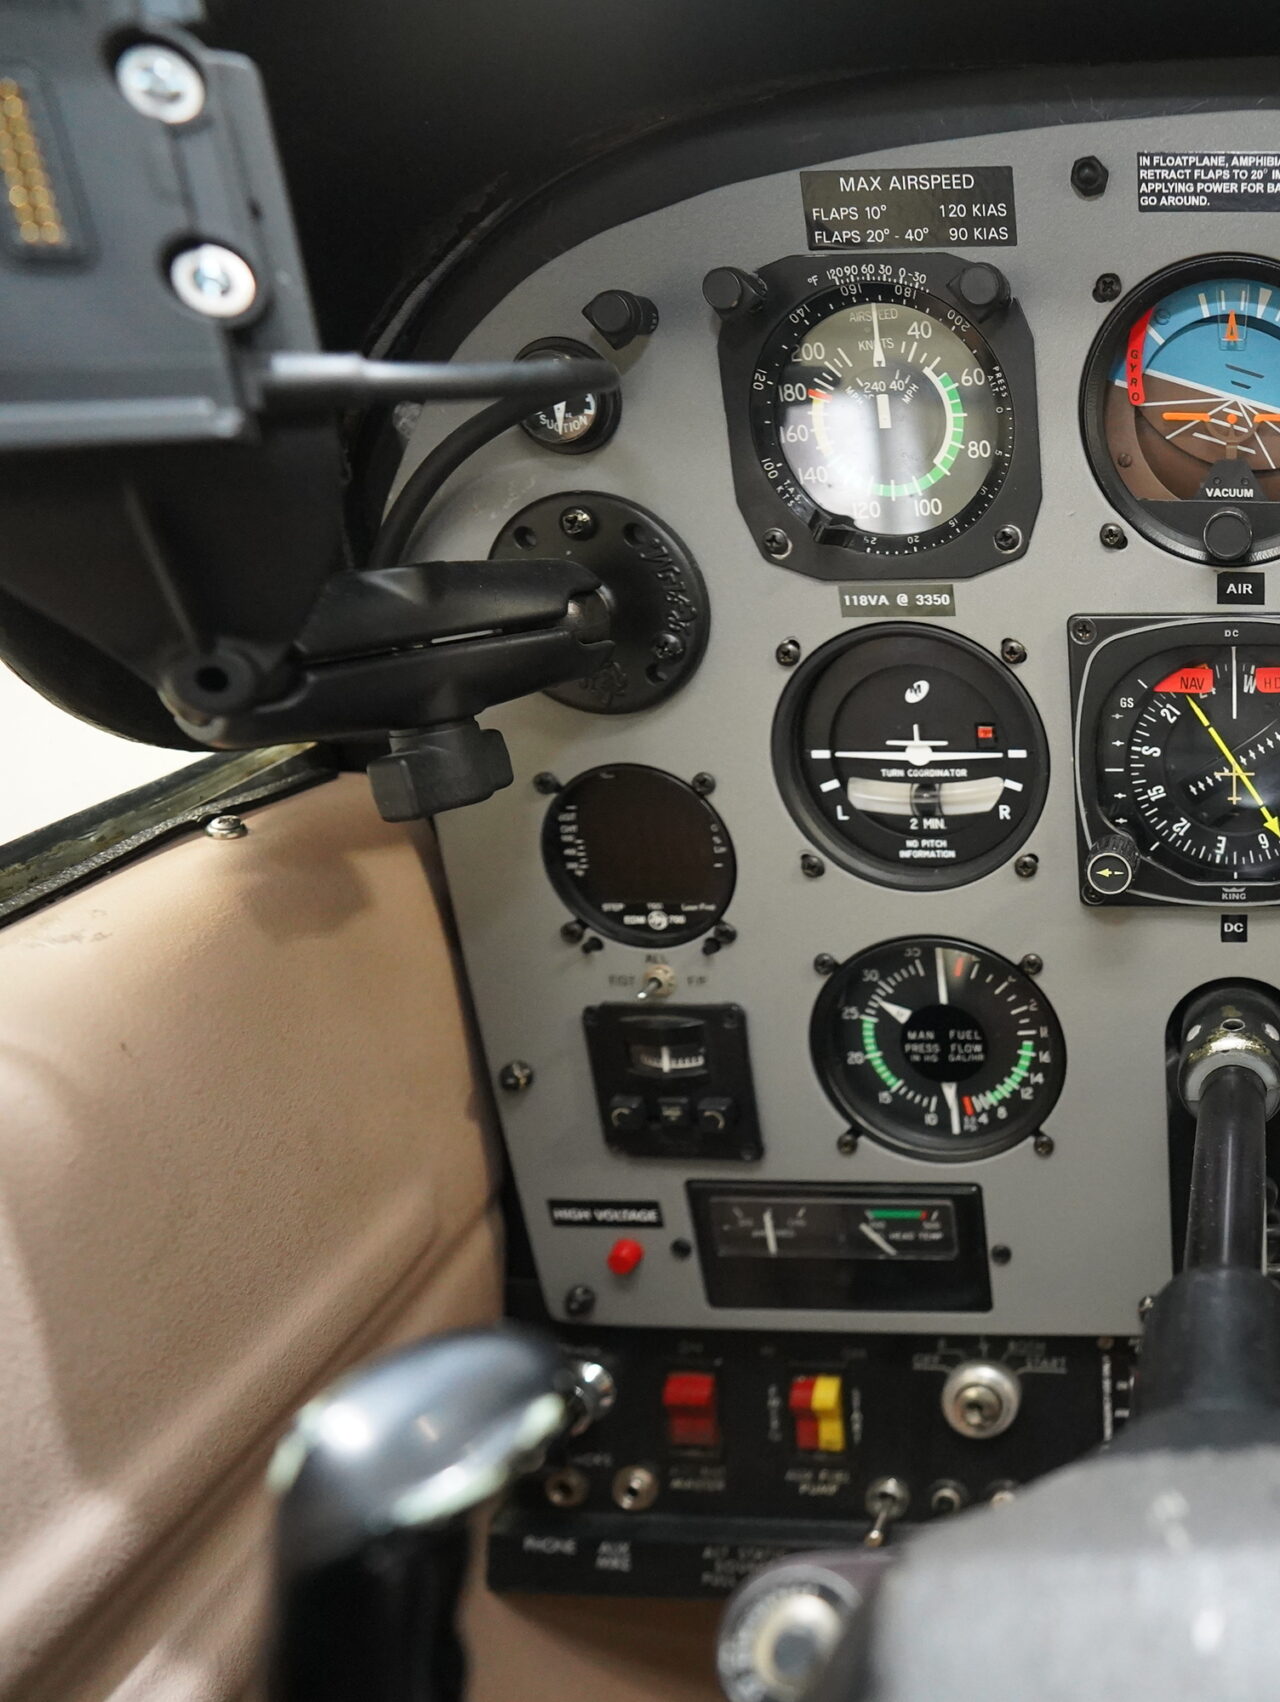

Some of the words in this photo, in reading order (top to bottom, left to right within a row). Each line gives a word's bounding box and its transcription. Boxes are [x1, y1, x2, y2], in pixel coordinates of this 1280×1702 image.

[1140, 156, 1150, 167] IN
[1153, 156, 1228, 167] FLOATPLANE,
[1140, 169, 1190, 179] RETRACT
[1194, 170, 1229, 180] FLAPS
[1233, 170, 1248, 180] TO
[839, 176, 882, 192] MAX
[889, 174, 974, 190] AIRSPEED
[1140, 183, 1194, 193] APPLYING
[1197, 183, 1238, 193] POWER
[1241, 183, 1264, 194] FOR
[1140, 196, 1157, 206] GO
[1159, 196, 1210, 206] AROUND.
[812, 207, 859, 221] FLAPS
[865, 205, 886, 220] 10°
[939, 203, 968, 218] 120
[973, 203, 1007, 217] KIAS
[814, 229, 861, 245] FLAPS
[866, 228, 891, 243] 20°
[904, 227, 929, 242] 40°
[949, 227, 969, 241] 90
[973, 226, 1008, 241] KIAS
[907, 321, 932, 339] 40
[960, 368, 985, 386] 60
[778, 384, 807, 401] 180
[780, 425, 808, 444] 160
[968, 441, 991, 459] 80
[1206, 488, 1253, 498] VACUUM
[914, 497, 942, 516] 100
[1226, 583, 1253, 594] AIR
[844, 595, 889, 606] 118VA
[896, 594, 909, 606] @
[915, 594, 950, 606] 3350
[1180, 677, 1204, 690] NAV
[1120, 698, 1134, 708] GS
[881, 769, 904, 777] TURN
[907, 769, 968, 777] COORDINATOR
[837, 805, 849, 820] L
[999, 805, 1011, 819] R
[910, 819, 918, 830] 2
[923, 819, 946, 830] MIN.
[906, 840, 919, 848] NO
[922, 840, 947, 848] PITCH
[899, 850, 955, 858] INFORMATION
[1222, 892, 1246, 900] KING
[1224, 922, 1243, 932] DC
[553, 1208, 590, 1222] HIGH
[594, 1209, 659, 1222] VOLTAGE
